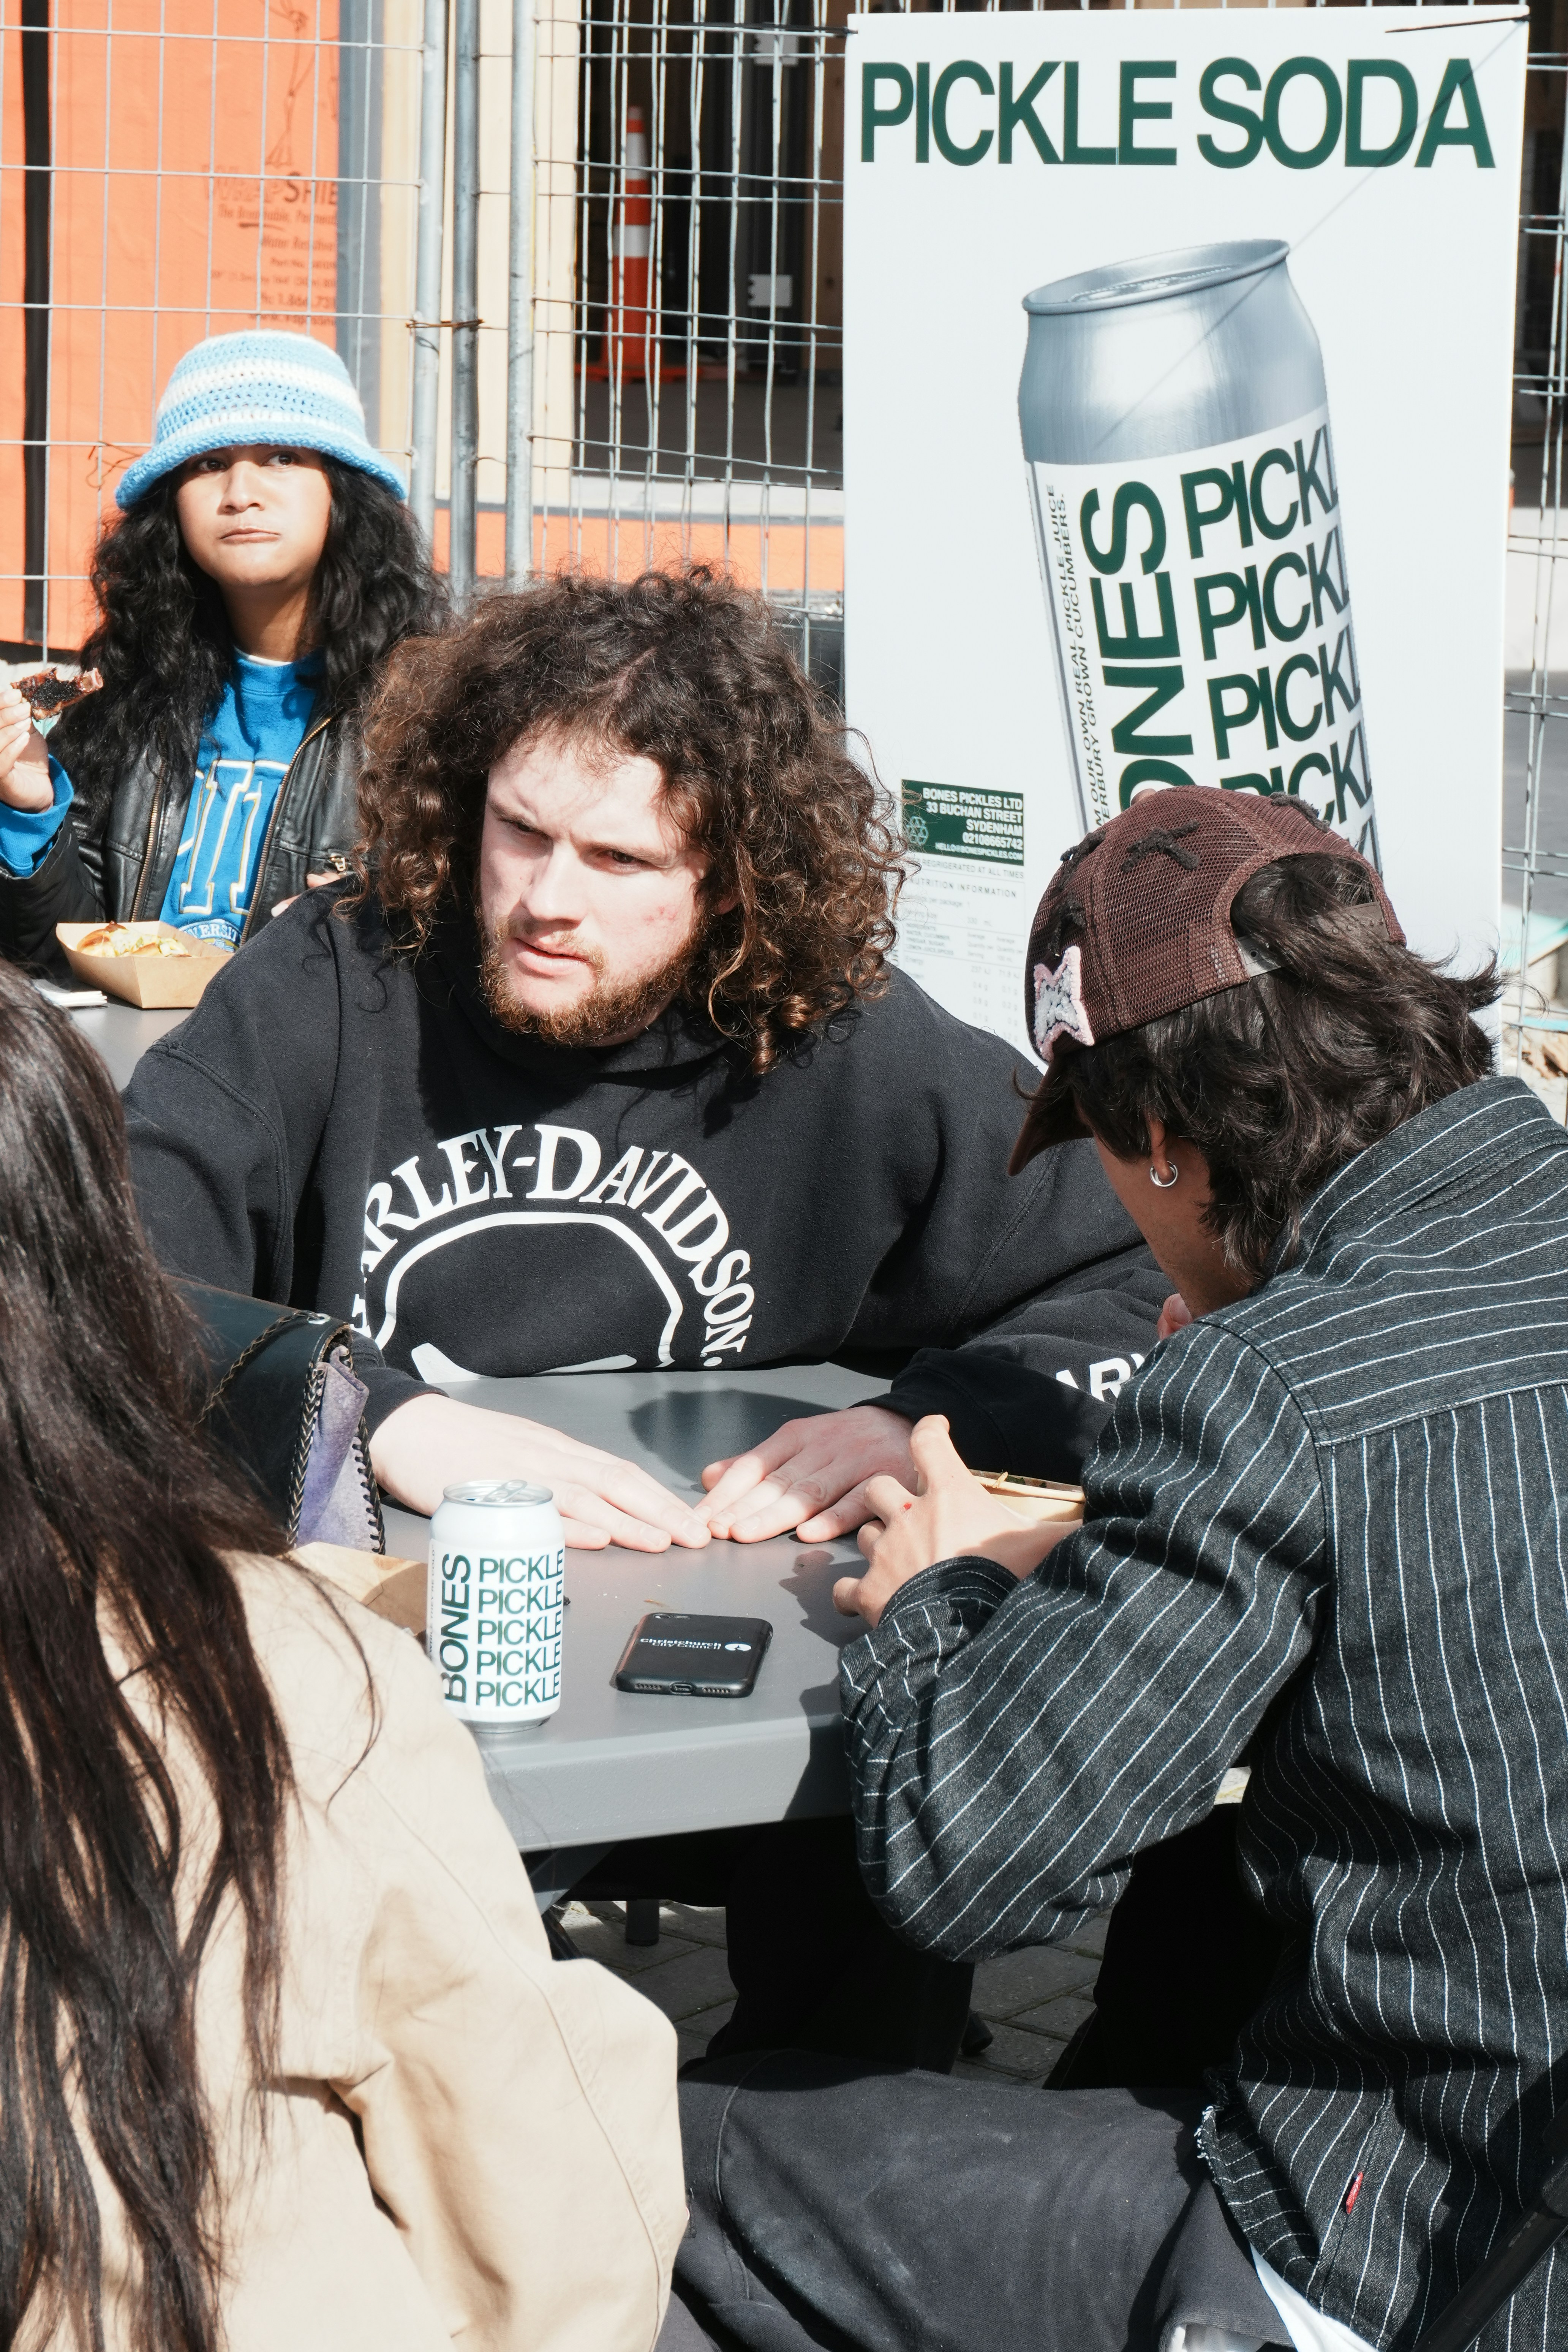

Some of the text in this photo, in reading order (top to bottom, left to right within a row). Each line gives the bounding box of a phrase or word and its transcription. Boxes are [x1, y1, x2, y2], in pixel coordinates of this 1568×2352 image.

[861, 56, 1496, 169] PICKLE SODA
[1057, 493, 1084, 639] CUCUMBERS.
[1046, 484, 1099, 803] OUR OWN REAL PICKLE JUICE
[1078, 645, 1097, 727] GROWN
[923, 787, 1023, 810] BONES PICKLES LTD
[926, 801, 1023, 823] 33 BUCHAN STREET
[966, 819, 1023, 837] SYDENHAM
[957, 884, 1016, 898] INFORMATION
[1004, 869, 1024, 879] TIMES
[479, 1549, 564, 1583] PICKLE
[478, 1579, 563, 1614] PICKLE
[439, 1553, 471, 1703] BONES
[477, 1610, 562, 1645] PICKLE
[476, 1641, 561, 1676] PICKLE
[476, 1671, 560, 1706] PICKLE
